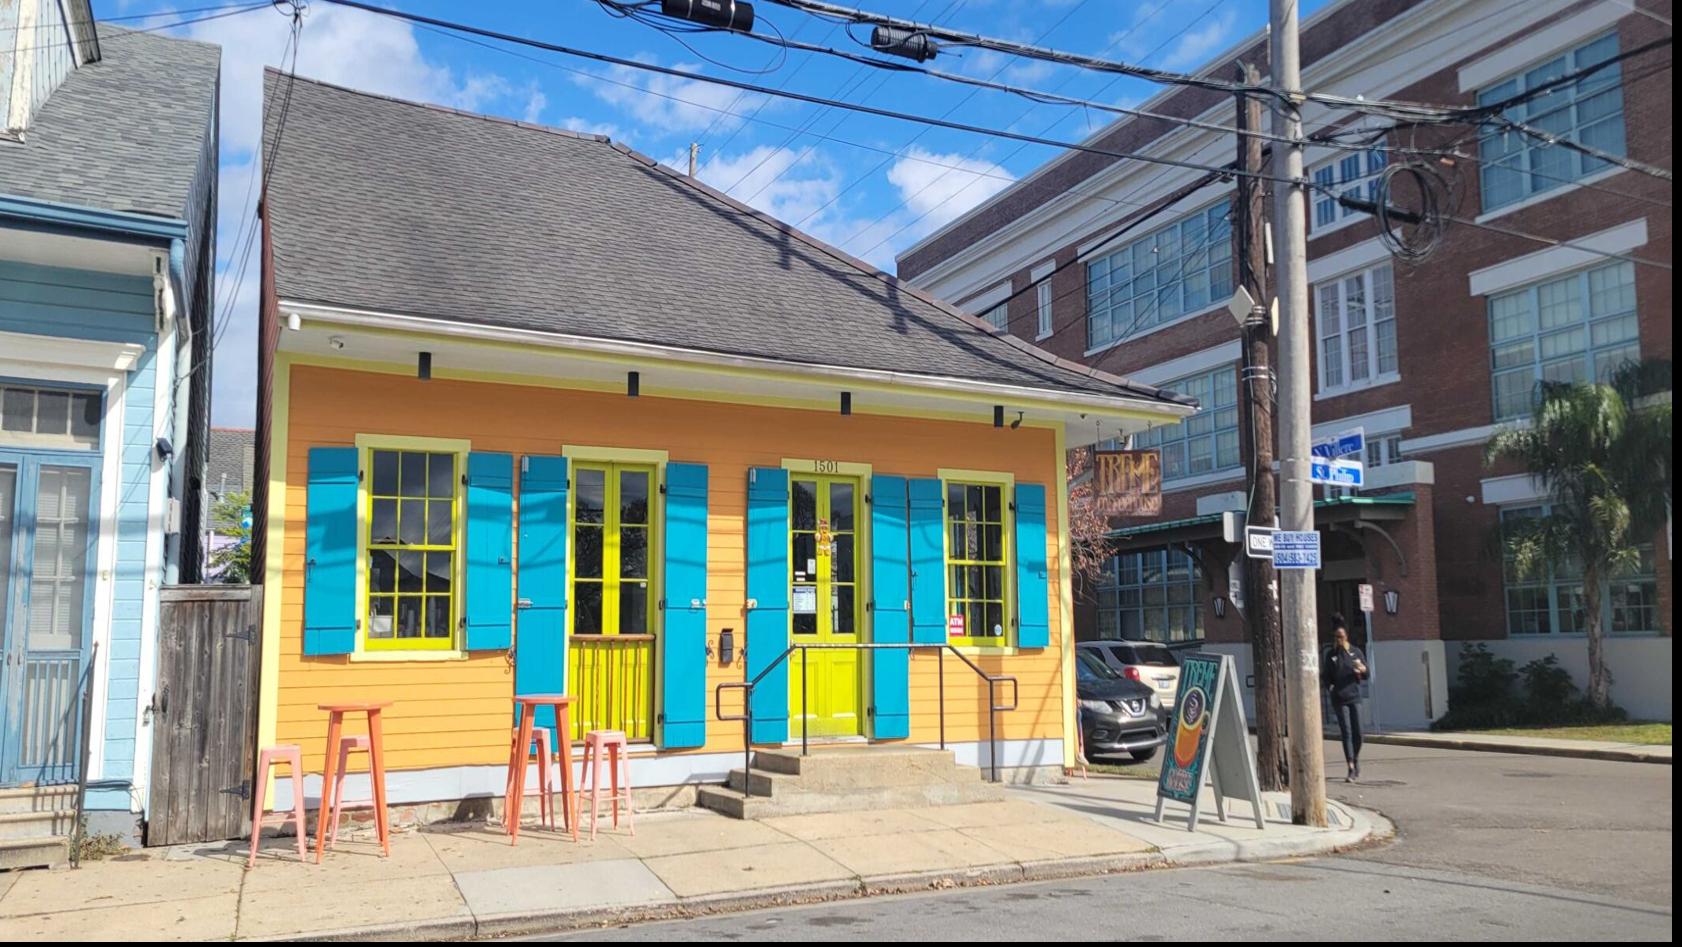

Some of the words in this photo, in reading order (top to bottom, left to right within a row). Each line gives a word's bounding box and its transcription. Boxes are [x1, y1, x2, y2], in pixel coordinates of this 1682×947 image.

[814, 460, 838, 473] 1501
[1096, 453, 1158, 494] TREME
[1252, 536, 1267, 548] ONE
[1274, 533, 1281, 542] WE
[1283, 533, 1294, 542] BUY
[1295, 533, 1318, 542] HOUSES
[950, 617, 964, 626] ATM
[1181, 659, 1218, 700] TREME
